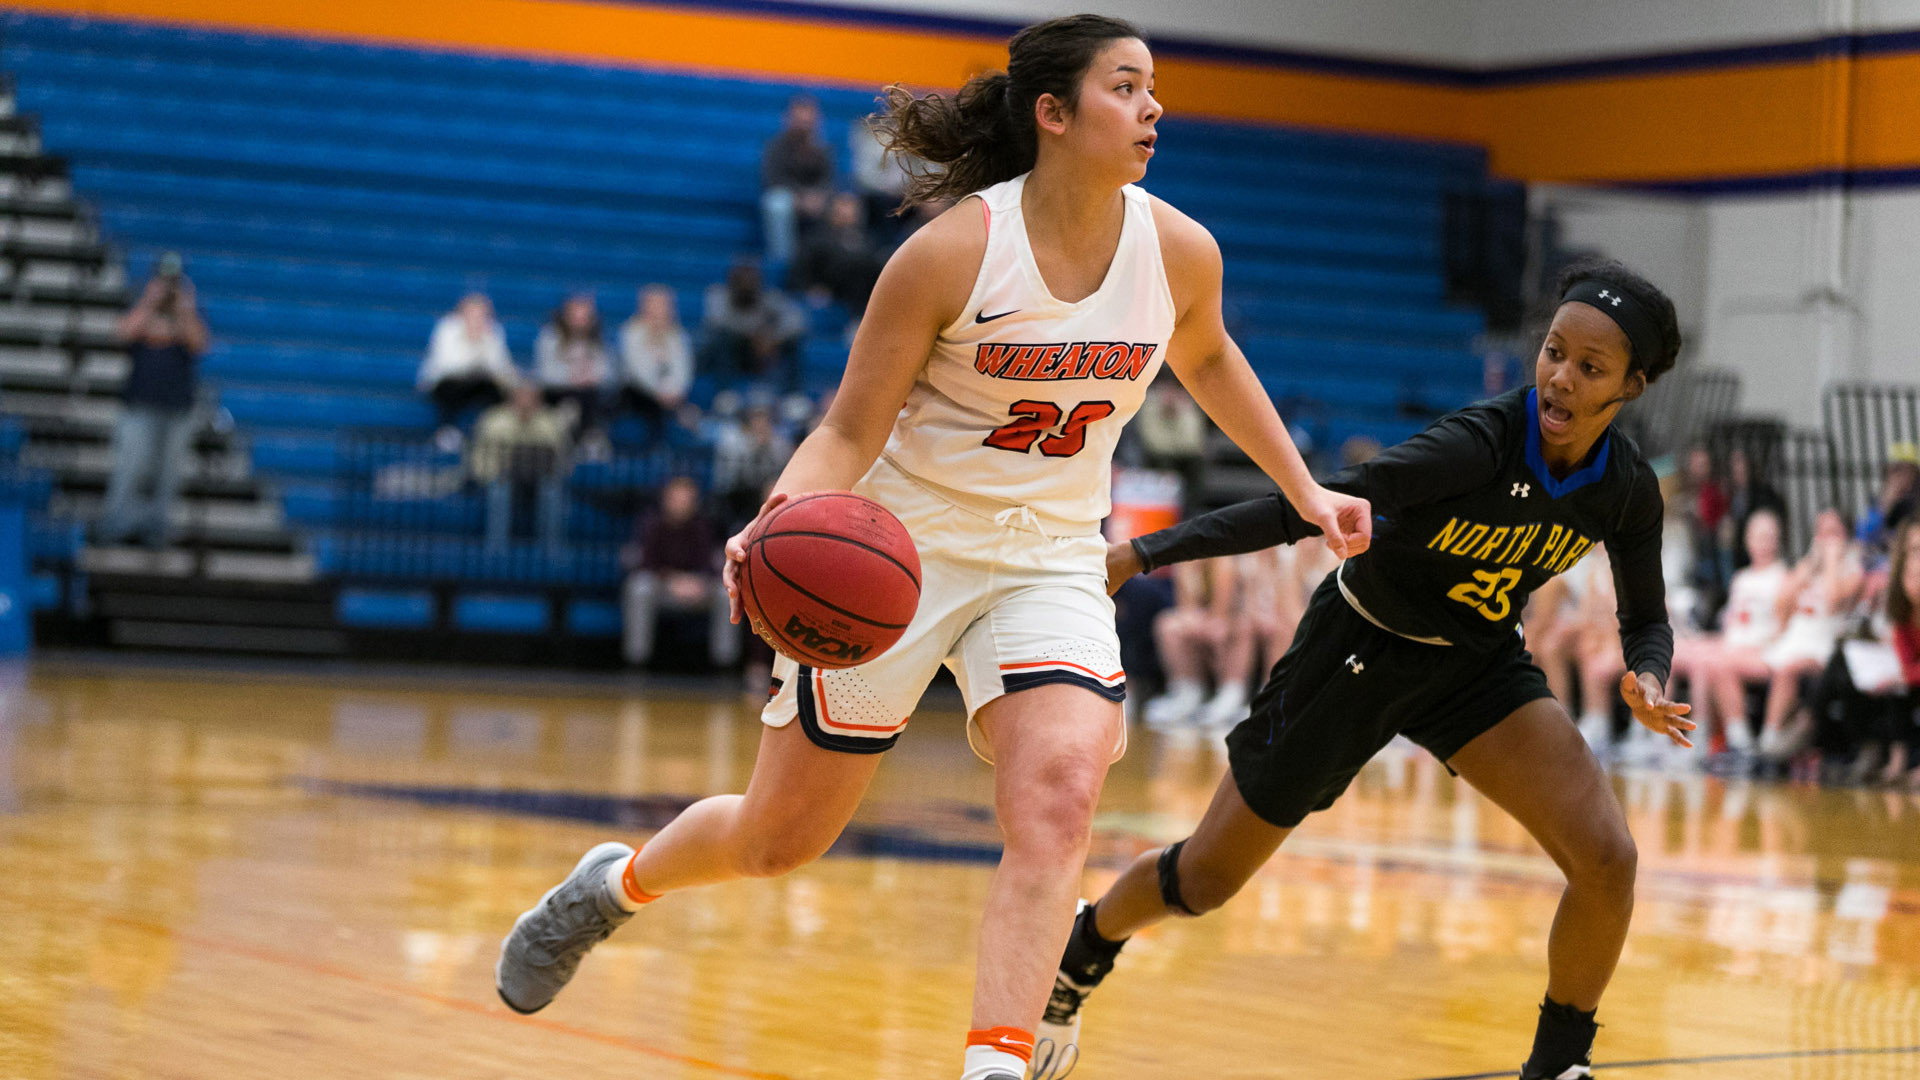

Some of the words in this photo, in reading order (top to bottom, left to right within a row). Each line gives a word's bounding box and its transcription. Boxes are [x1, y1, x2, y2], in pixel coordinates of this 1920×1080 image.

[974, 341, 1158, 381] WHEATON
[982, 399, 1115, 457] 23
[1427, 516, 1542, 565] NORTH
[1446, 567, 1523, 622] 23
[784, 614, 873, 661] NCAA
